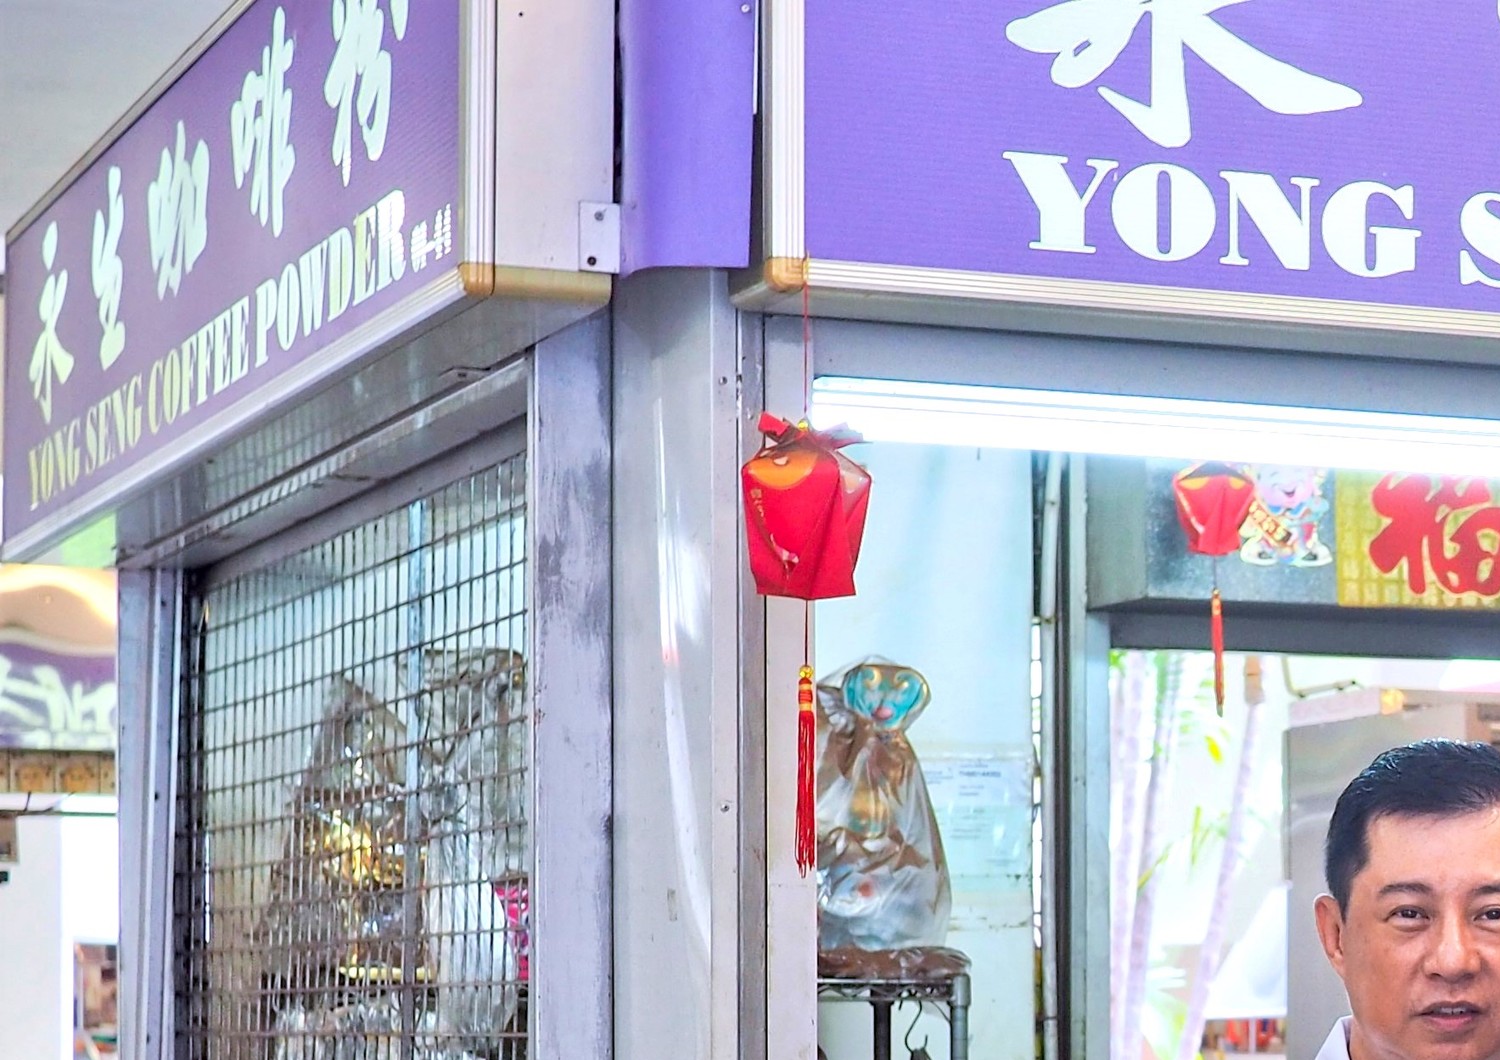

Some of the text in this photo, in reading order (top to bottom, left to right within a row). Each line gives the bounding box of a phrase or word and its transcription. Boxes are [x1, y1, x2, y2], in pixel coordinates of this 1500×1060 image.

[1002, 151, 1421, 278] YONG
[29, 189, 452, 511] YONG SENG COFFEE POWDER 01-44
